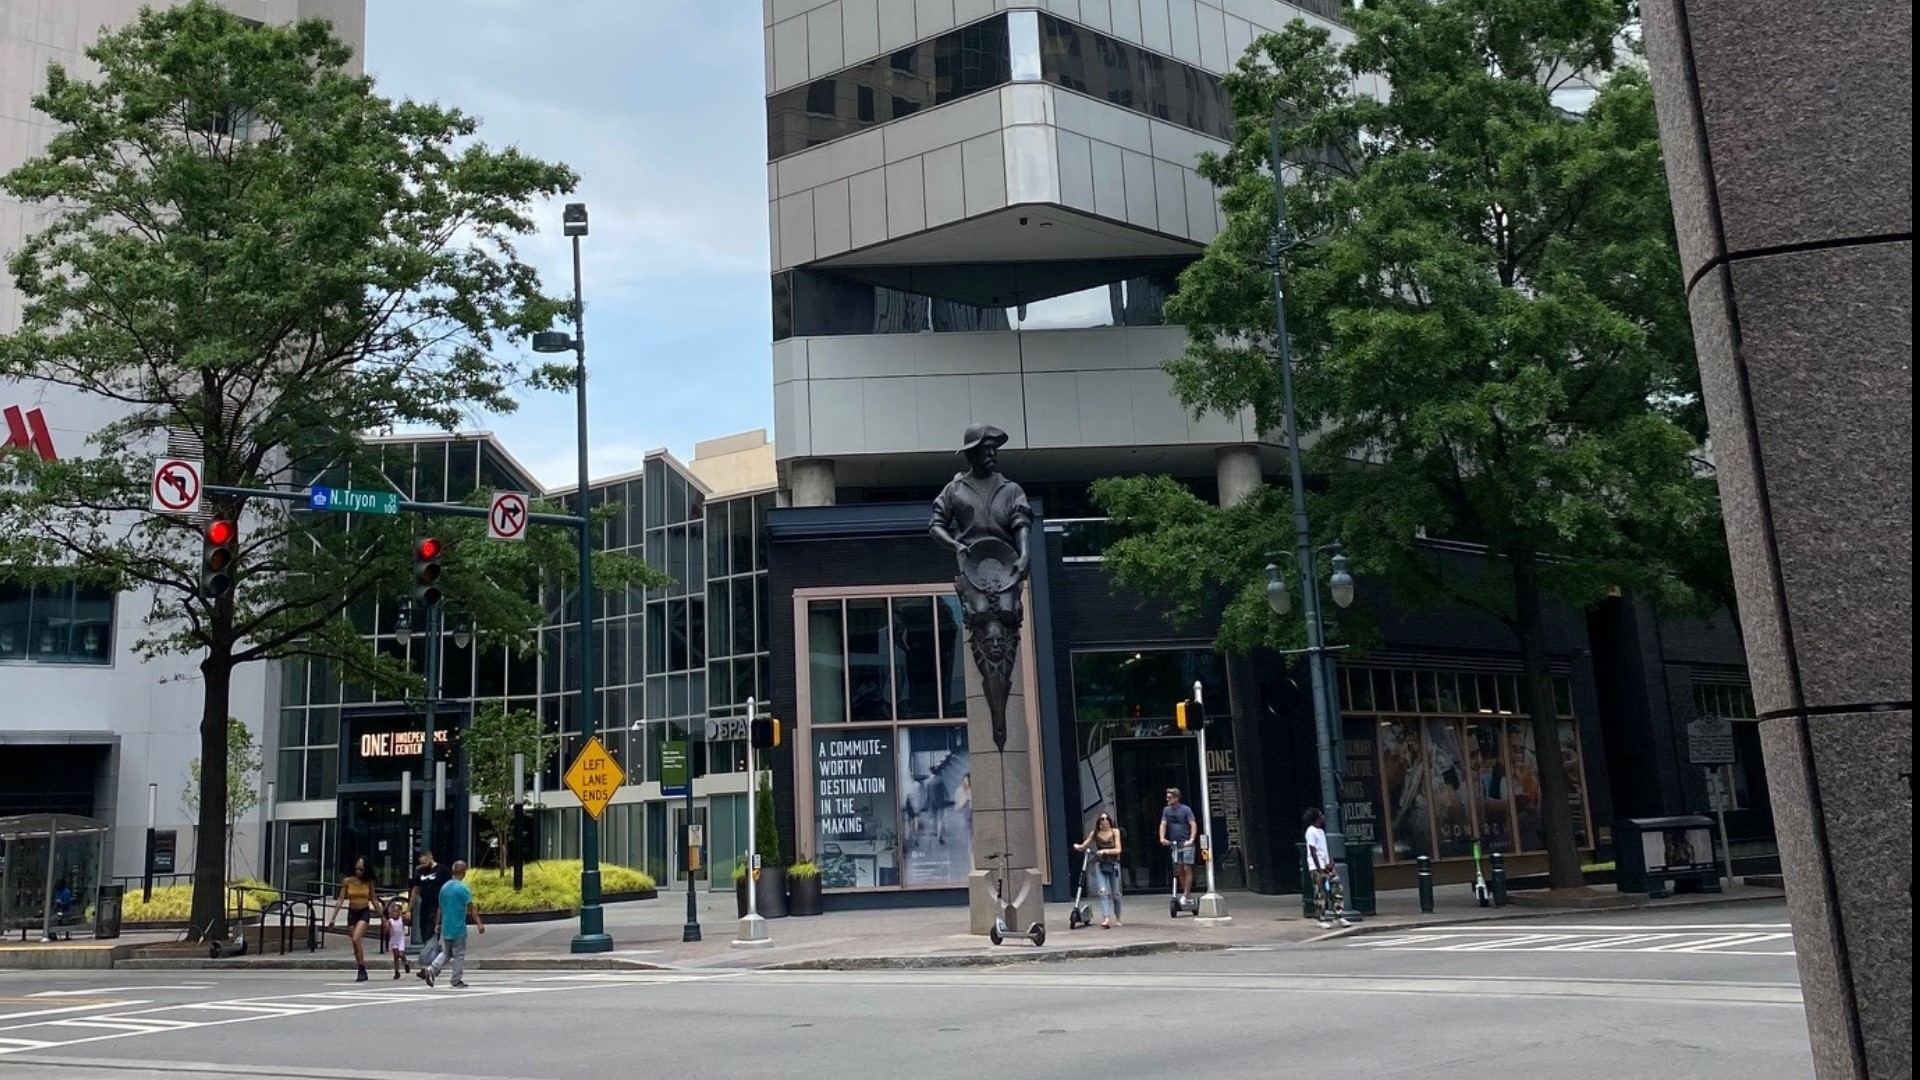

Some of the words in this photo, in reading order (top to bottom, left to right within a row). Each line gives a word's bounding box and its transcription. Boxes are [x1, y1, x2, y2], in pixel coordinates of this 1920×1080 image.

[330, 489, 342, 505] N.
[344, 490, 376, 511] Tryon
[384, 503, 397, 514] 100
[361, 733, 390, 757] ONE
[395, 730, 448, 743] INDEPENNCE
[395, 743, 423, 755] CENTER
[819, 742, 826, 757] A
[830, 739, 887, 757] COMMUTE-
[583, 758, 605, 771] LEFT
[819, 759, 863, 776] WORTHY
[1206, 750, 1235, 772] ONE
[582, 774, 608, 786] LANE
[820, 777, 886, 796] DESTINATION
[583, 789, 608, 802] ENDS
[1209, 781, 1224, 817] CENTER
[821, 799, 831, 815] IN
[835, 798, 855, 814] THE
[821, 817, 862, 834] MAKING
